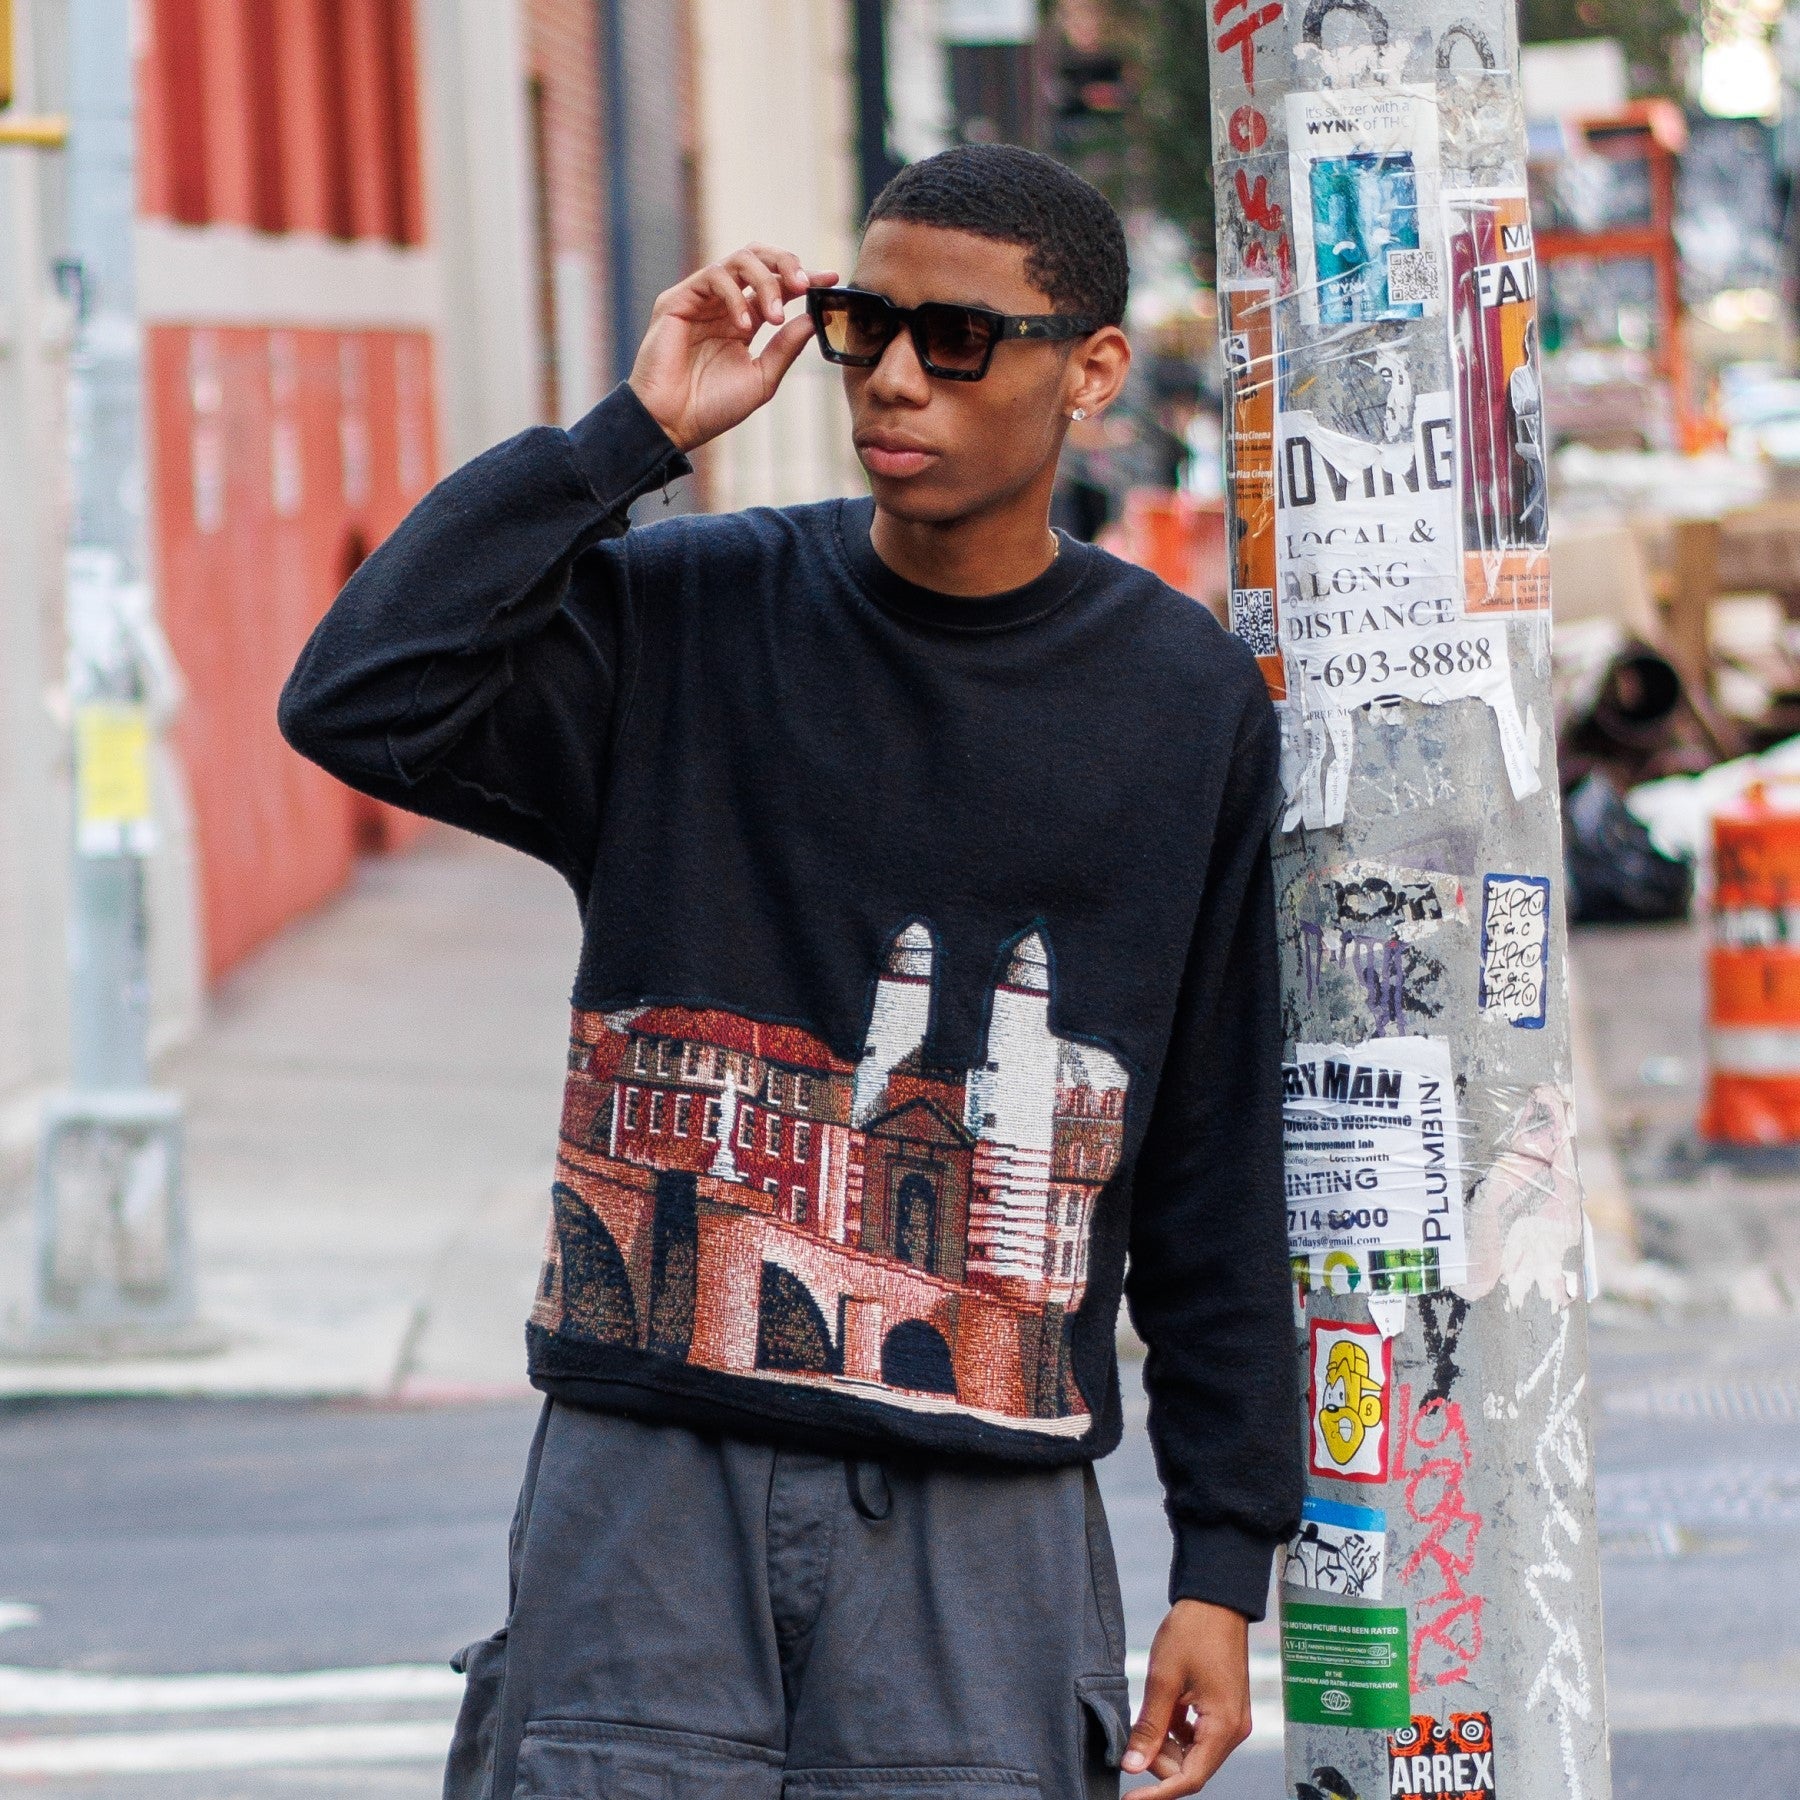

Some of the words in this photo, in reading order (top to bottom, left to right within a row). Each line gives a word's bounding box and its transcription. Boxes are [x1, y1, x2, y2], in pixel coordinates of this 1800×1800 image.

[1371, 101, 1399, 114] with
[1402, 101, 1410, 112] a
[1363, 117, 1377, 131] of
[1409, 518, 1436, 543] &
[1309, 561, 1411, 598] LONG
[1286, 598, 1456, 641] DISTANCE
[1341, 1114, 1413, 1131] Welcome
[1329, 1153, 1390, 1163] Locksmith
[1418, 1074, 1451, 1244] PLUMBIN
[1285, 1167, 1378, 1197] INTING
[1289, 1620, 1312, 1632] MOTION
[1312, 1622, 1338, 1633] PICTURE
[1339, 1625, 1352, 1634] HAS
[1352, 1626, 1370, 1635] BEEN
[1371, 1626, 1399, 1636] RATED
[1391, 1752, 1496, 1795] ARREX
